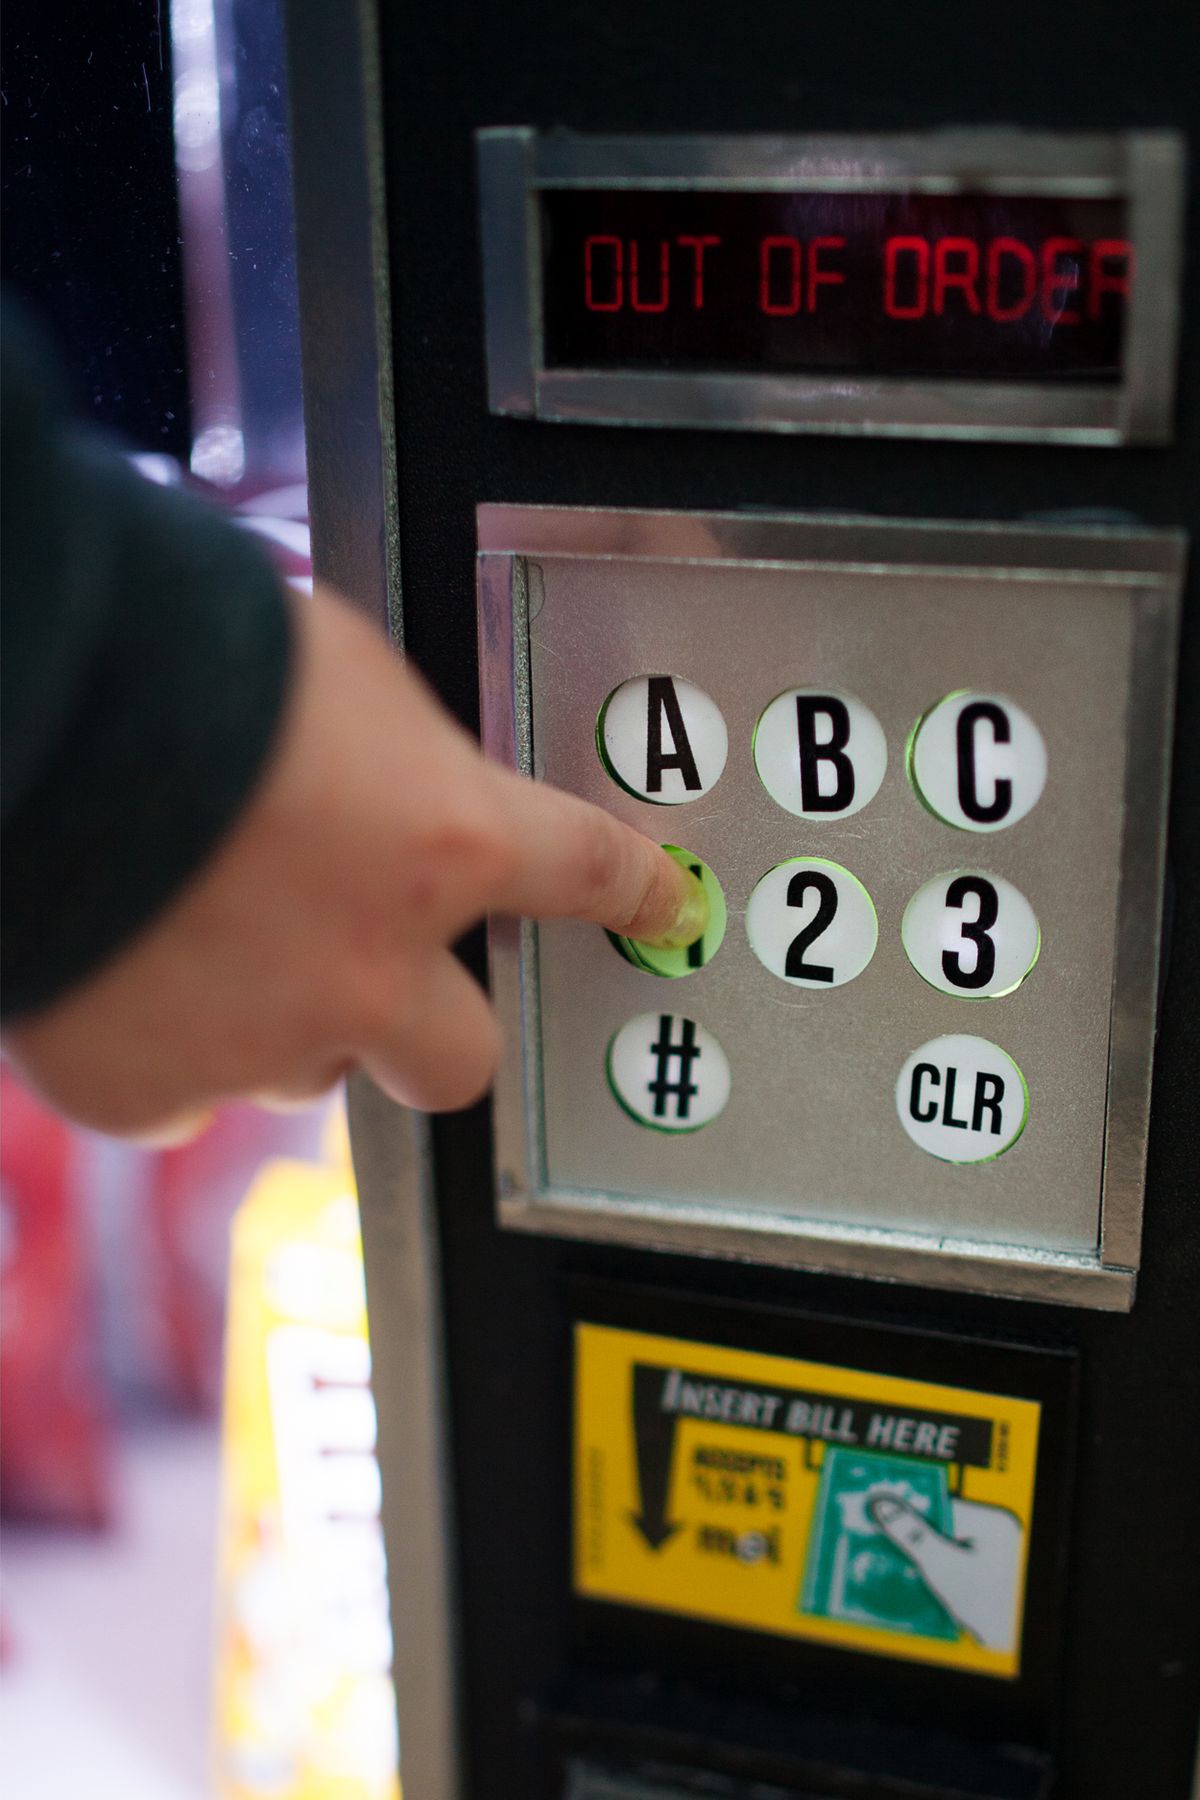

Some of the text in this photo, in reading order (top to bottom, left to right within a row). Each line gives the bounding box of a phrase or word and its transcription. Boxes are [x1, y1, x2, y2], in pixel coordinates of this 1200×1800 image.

[585, 235, 720, 312] OUT
[760, 236, 847, 316] OF
[646, 676, 702, 793] A
[796, 695, 855, 812] B
[956, 702, 1012, 823] C
[784, 870, 838, 983] 2
[941, 875, 999, 989] 3
[647, 1014, 701, 1118] #
[908, 1062, 1005, 1135] CLR
[661, 1368, 782, 1428] INSERT
[784, 1398, 858, 1443] BILL
[867, 1413, 961, 1459] HERE
